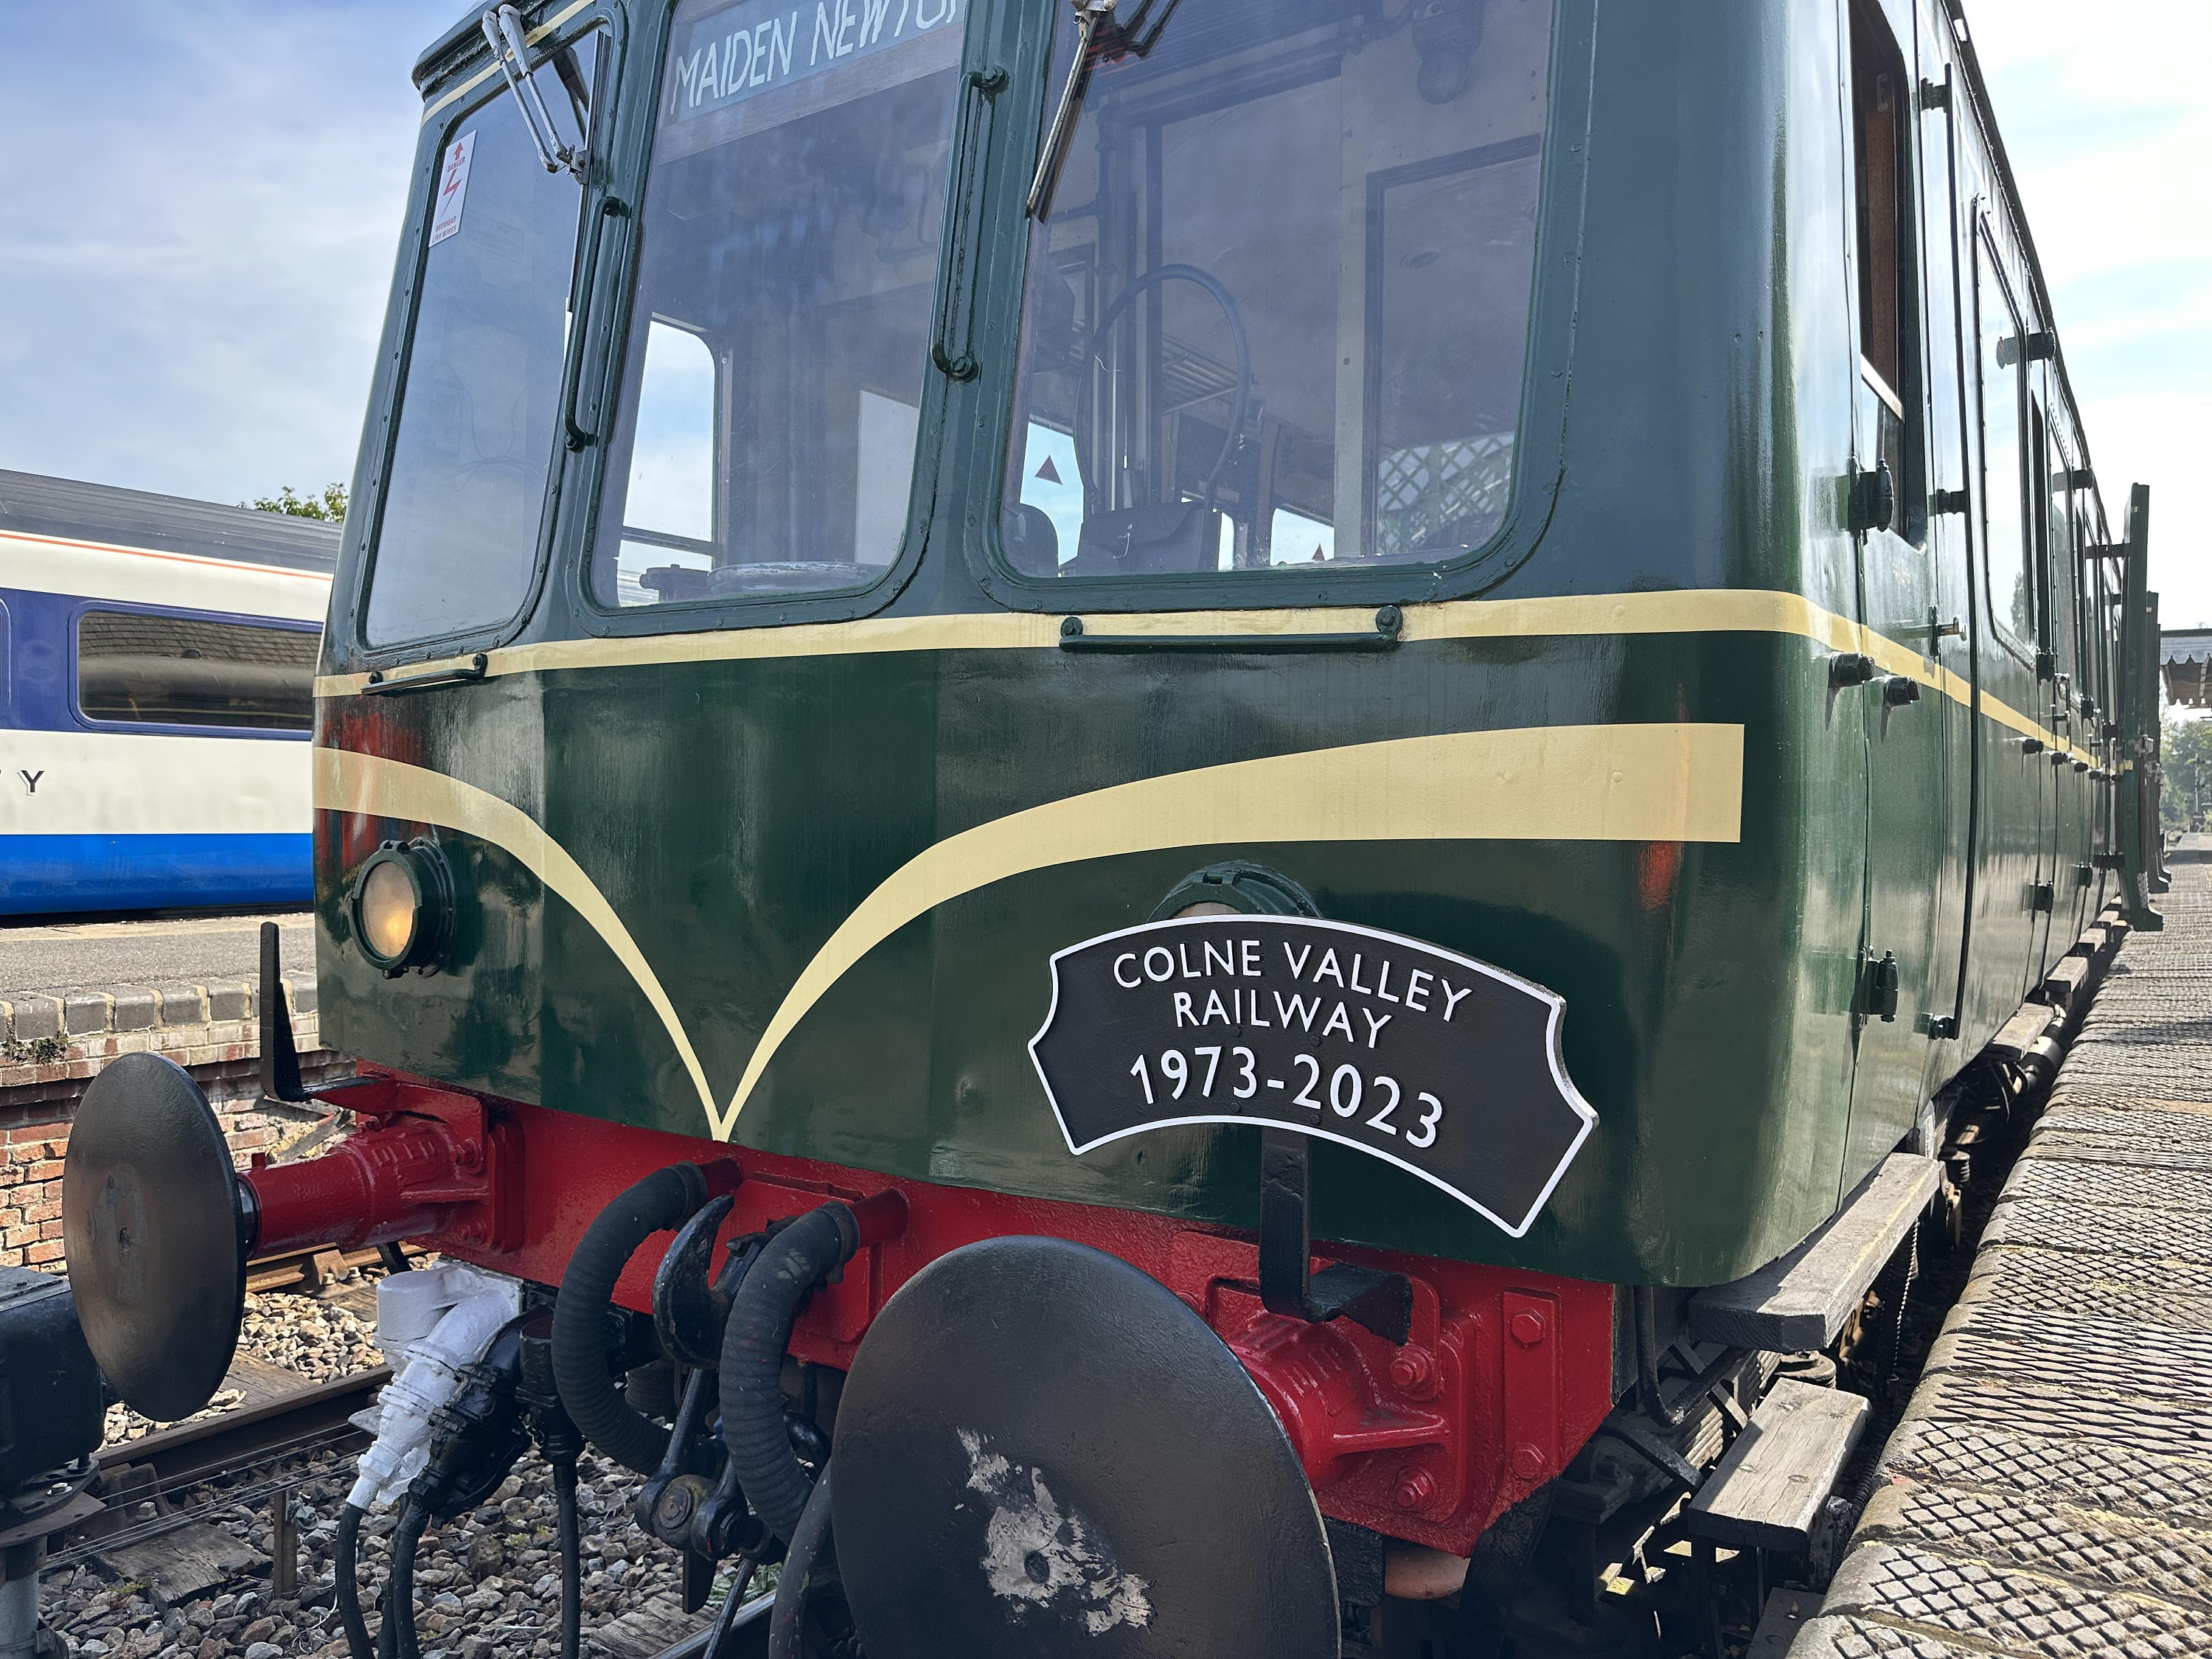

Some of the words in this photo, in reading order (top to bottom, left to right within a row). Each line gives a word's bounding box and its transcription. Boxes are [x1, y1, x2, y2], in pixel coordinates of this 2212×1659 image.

[670, 10, 798, 116] MAIDEN
[447, 156, 466, 173] DANGER
[431, 232, 442, 243] LIVE
[442, 224, 457, 238] WIRES
[435, 215, 457, 232] OVERHEAD
[1113, 939, 1262, 989] COLNE
[1283, 942, 1473, 1023] VALLEY
[1173, 988, 1393, 1050] RAILWAY
[1130, 1045, 1444, 1149] 1973-2023
